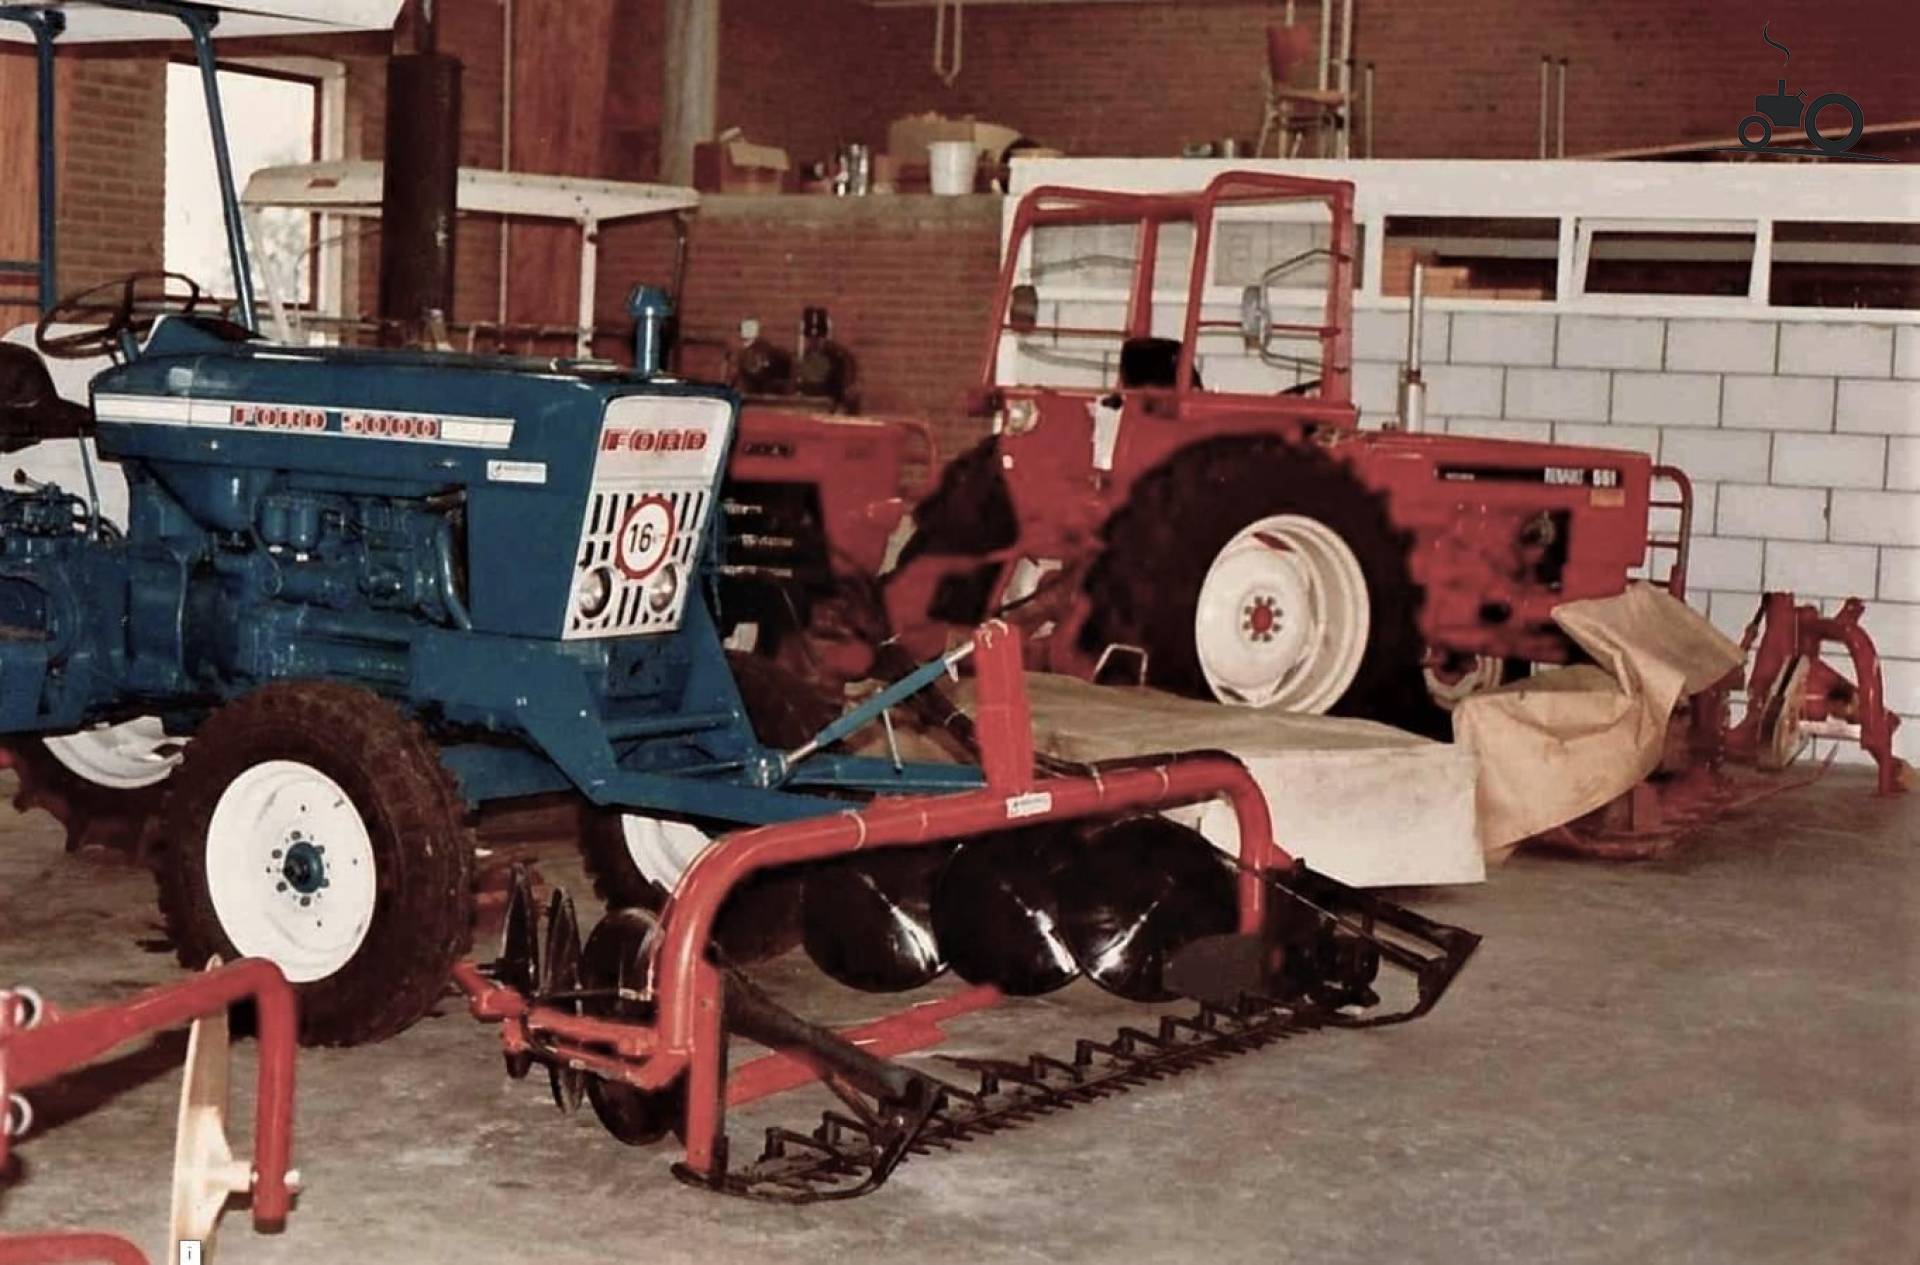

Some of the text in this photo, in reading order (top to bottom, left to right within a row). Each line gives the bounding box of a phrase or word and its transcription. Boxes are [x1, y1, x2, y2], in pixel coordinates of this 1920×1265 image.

[231, 405, 441, 440] FORD 5000
[602, 429, 708, 452] FORD
[629, 523, 654, 553] 16
